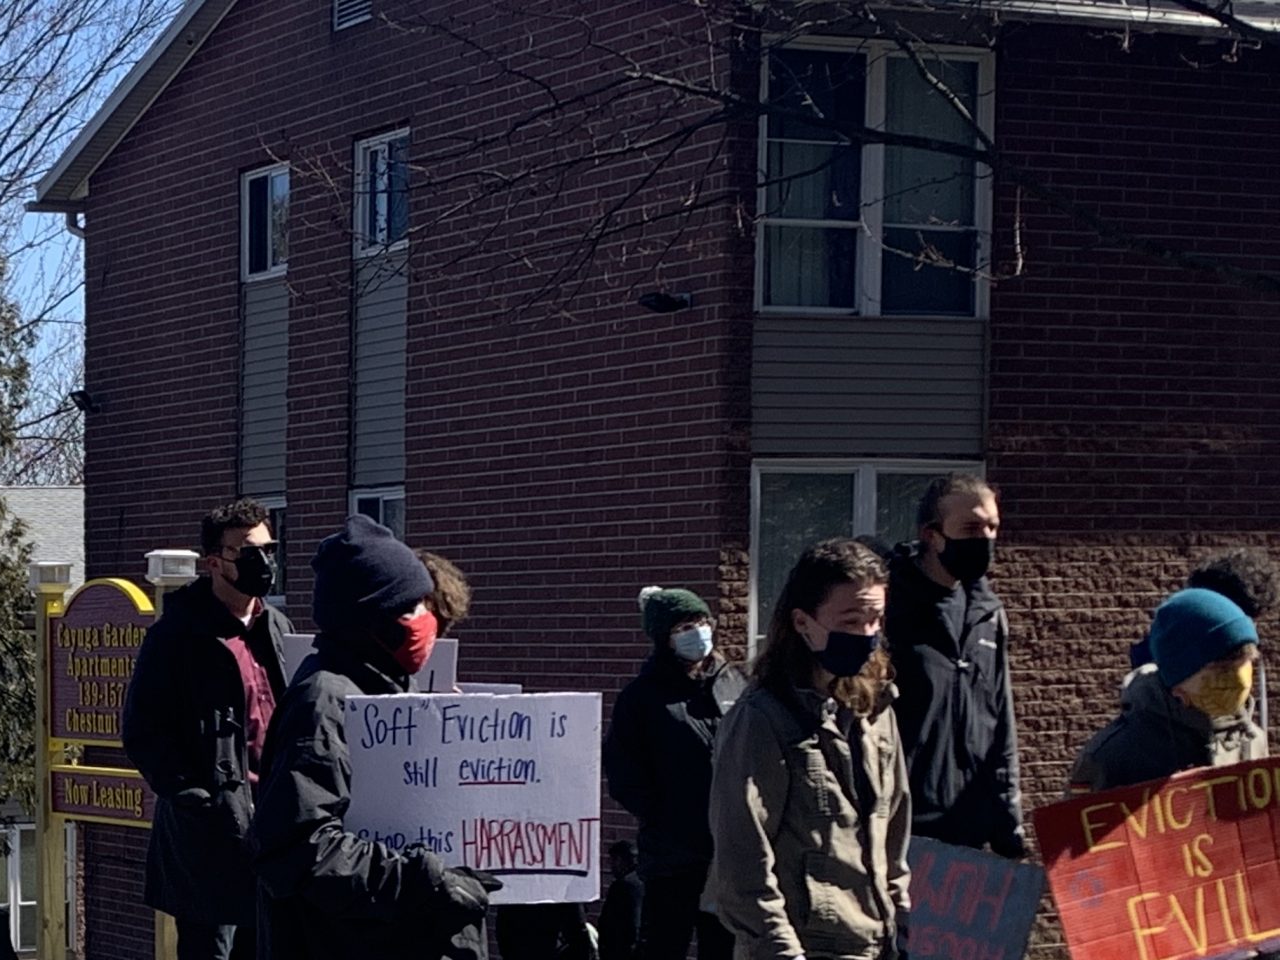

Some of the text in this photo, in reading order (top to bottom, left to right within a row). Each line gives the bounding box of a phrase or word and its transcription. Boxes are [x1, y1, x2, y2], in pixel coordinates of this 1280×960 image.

[57, 623, 99, 652] Cayuga
[79, 682, 124, 707] 139-157
[66, 708, 117, 734] Chestnut
[441, 704, 531, 744] Eviction
[550, 712, 567, 738] is
[403, 757, 541, 787] still eviction.
[64, 778, 142, 818] Now Leasing
[1081, 768, 1280, 853] EVICTIO
[416, 826, 454, 854] this
[462, 817, 600, 870] HARRASSMENT
[1182, 834, 1213, 878] IS
